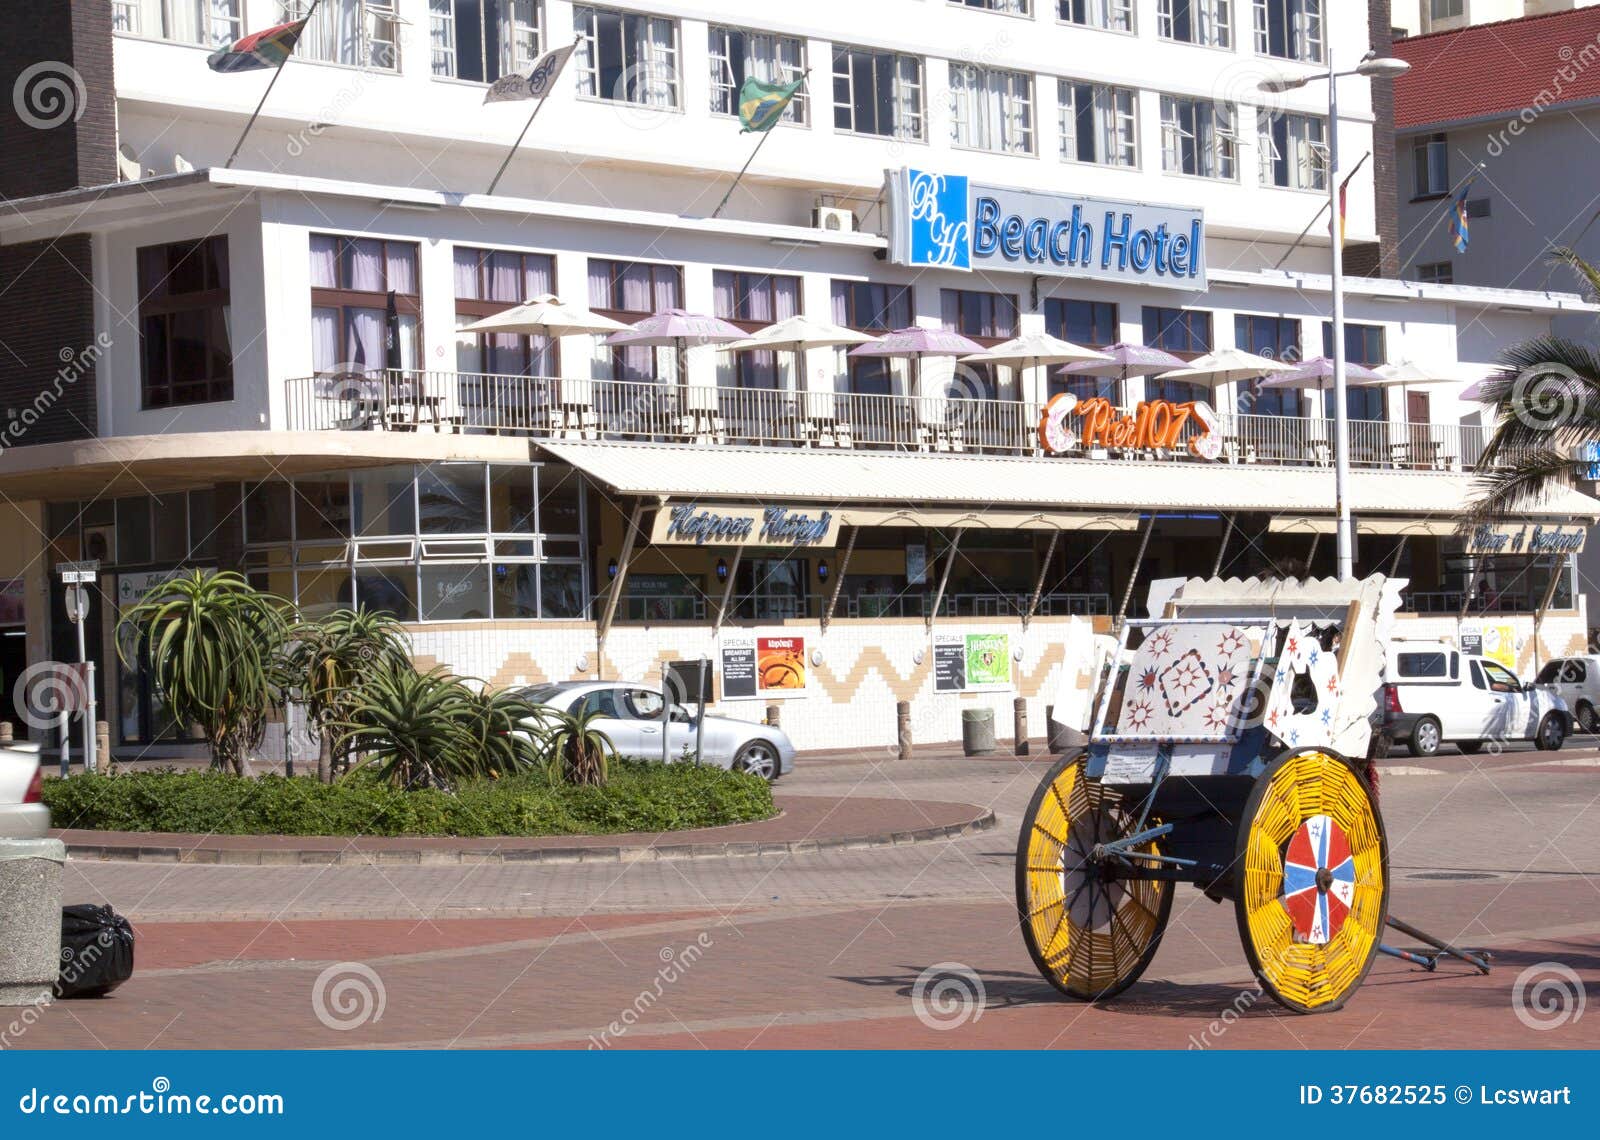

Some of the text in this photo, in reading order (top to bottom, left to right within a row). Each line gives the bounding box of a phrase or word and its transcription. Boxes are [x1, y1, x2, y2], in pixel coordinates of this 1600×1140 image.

[974, 196, 1202, 276] Beach Hotel
[723, 638, 755, 647] SPECIALS
[935, 635, 963, 643] SPECIALS
